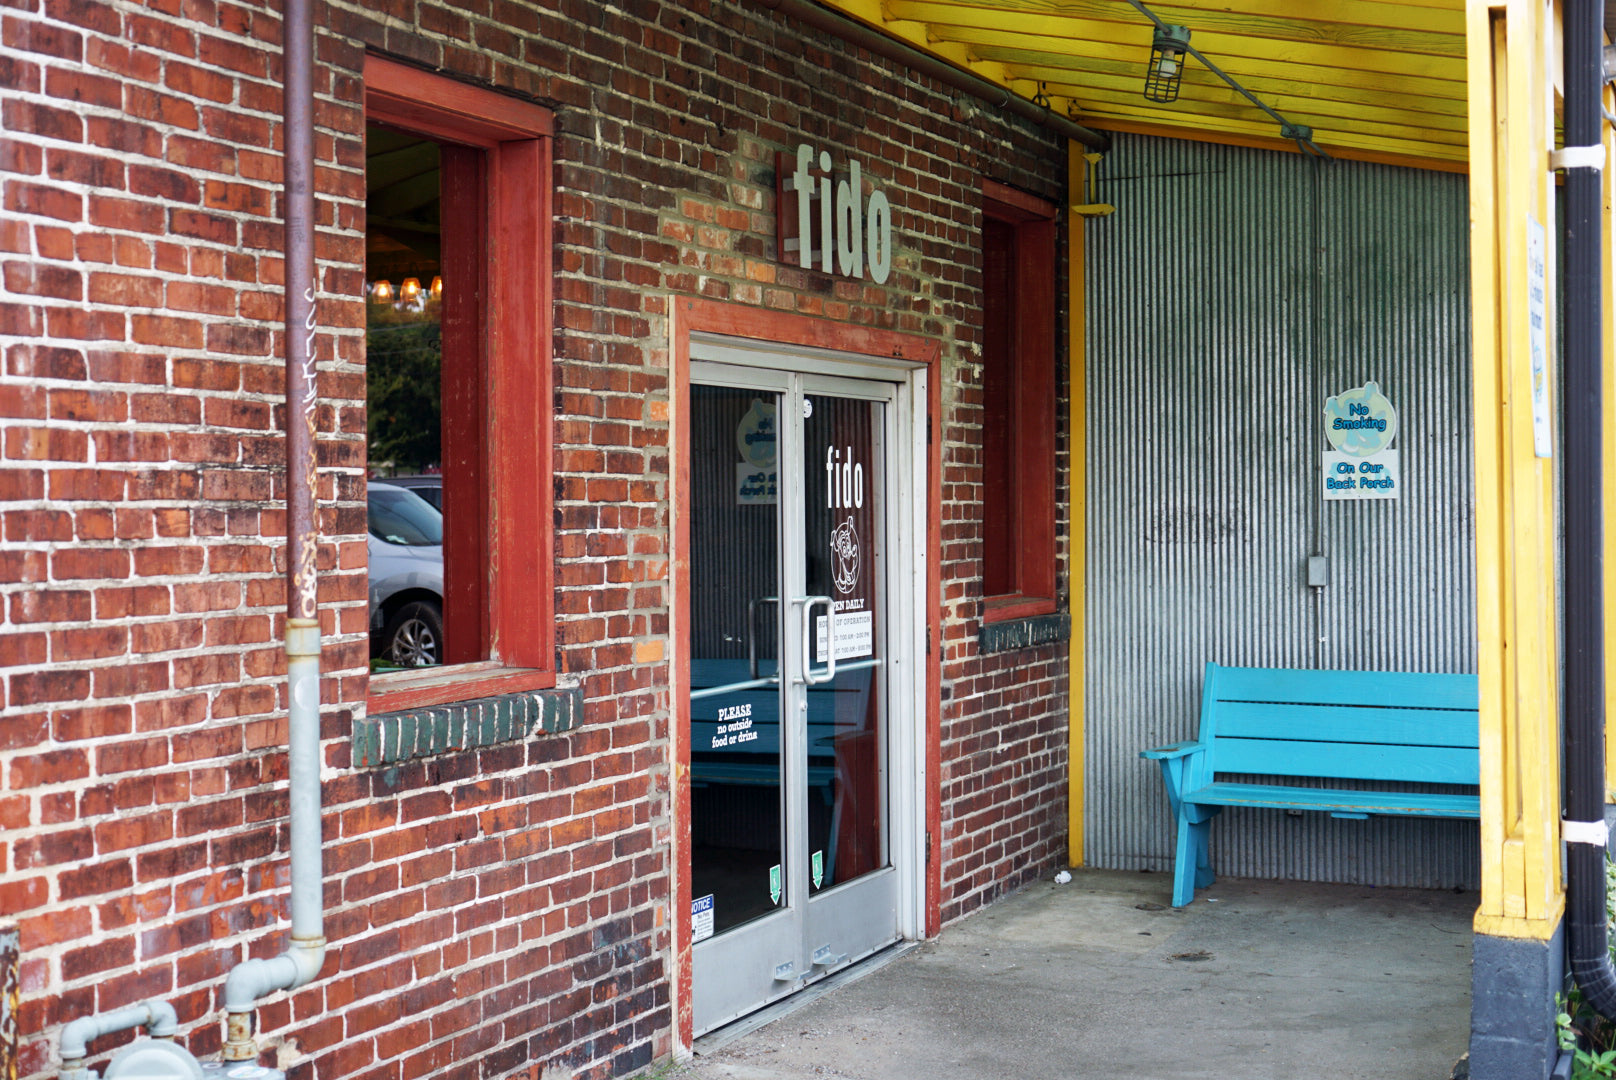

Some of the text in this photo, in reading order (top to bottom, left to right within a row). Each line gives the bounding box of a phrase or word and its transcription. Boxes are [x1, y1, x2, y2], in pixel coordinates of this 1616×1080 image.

[793, 143, 891, 285] fido
[1349, 403, 1369, 416] No
[1333, 416, 1387, 432] Smoking
[1337, 462, 1384, 474] On Our
[826, 445, 863, 509] fido
[1327, 476, 1395, 489] Back Porch
[845, 598, 865, 610] DAILY
[718, 703, 752, 721] PLEASE
[717, 717, 753, 734] no outside
[711, 734, 728, 749] food
[728, 735, 737, 744] or
